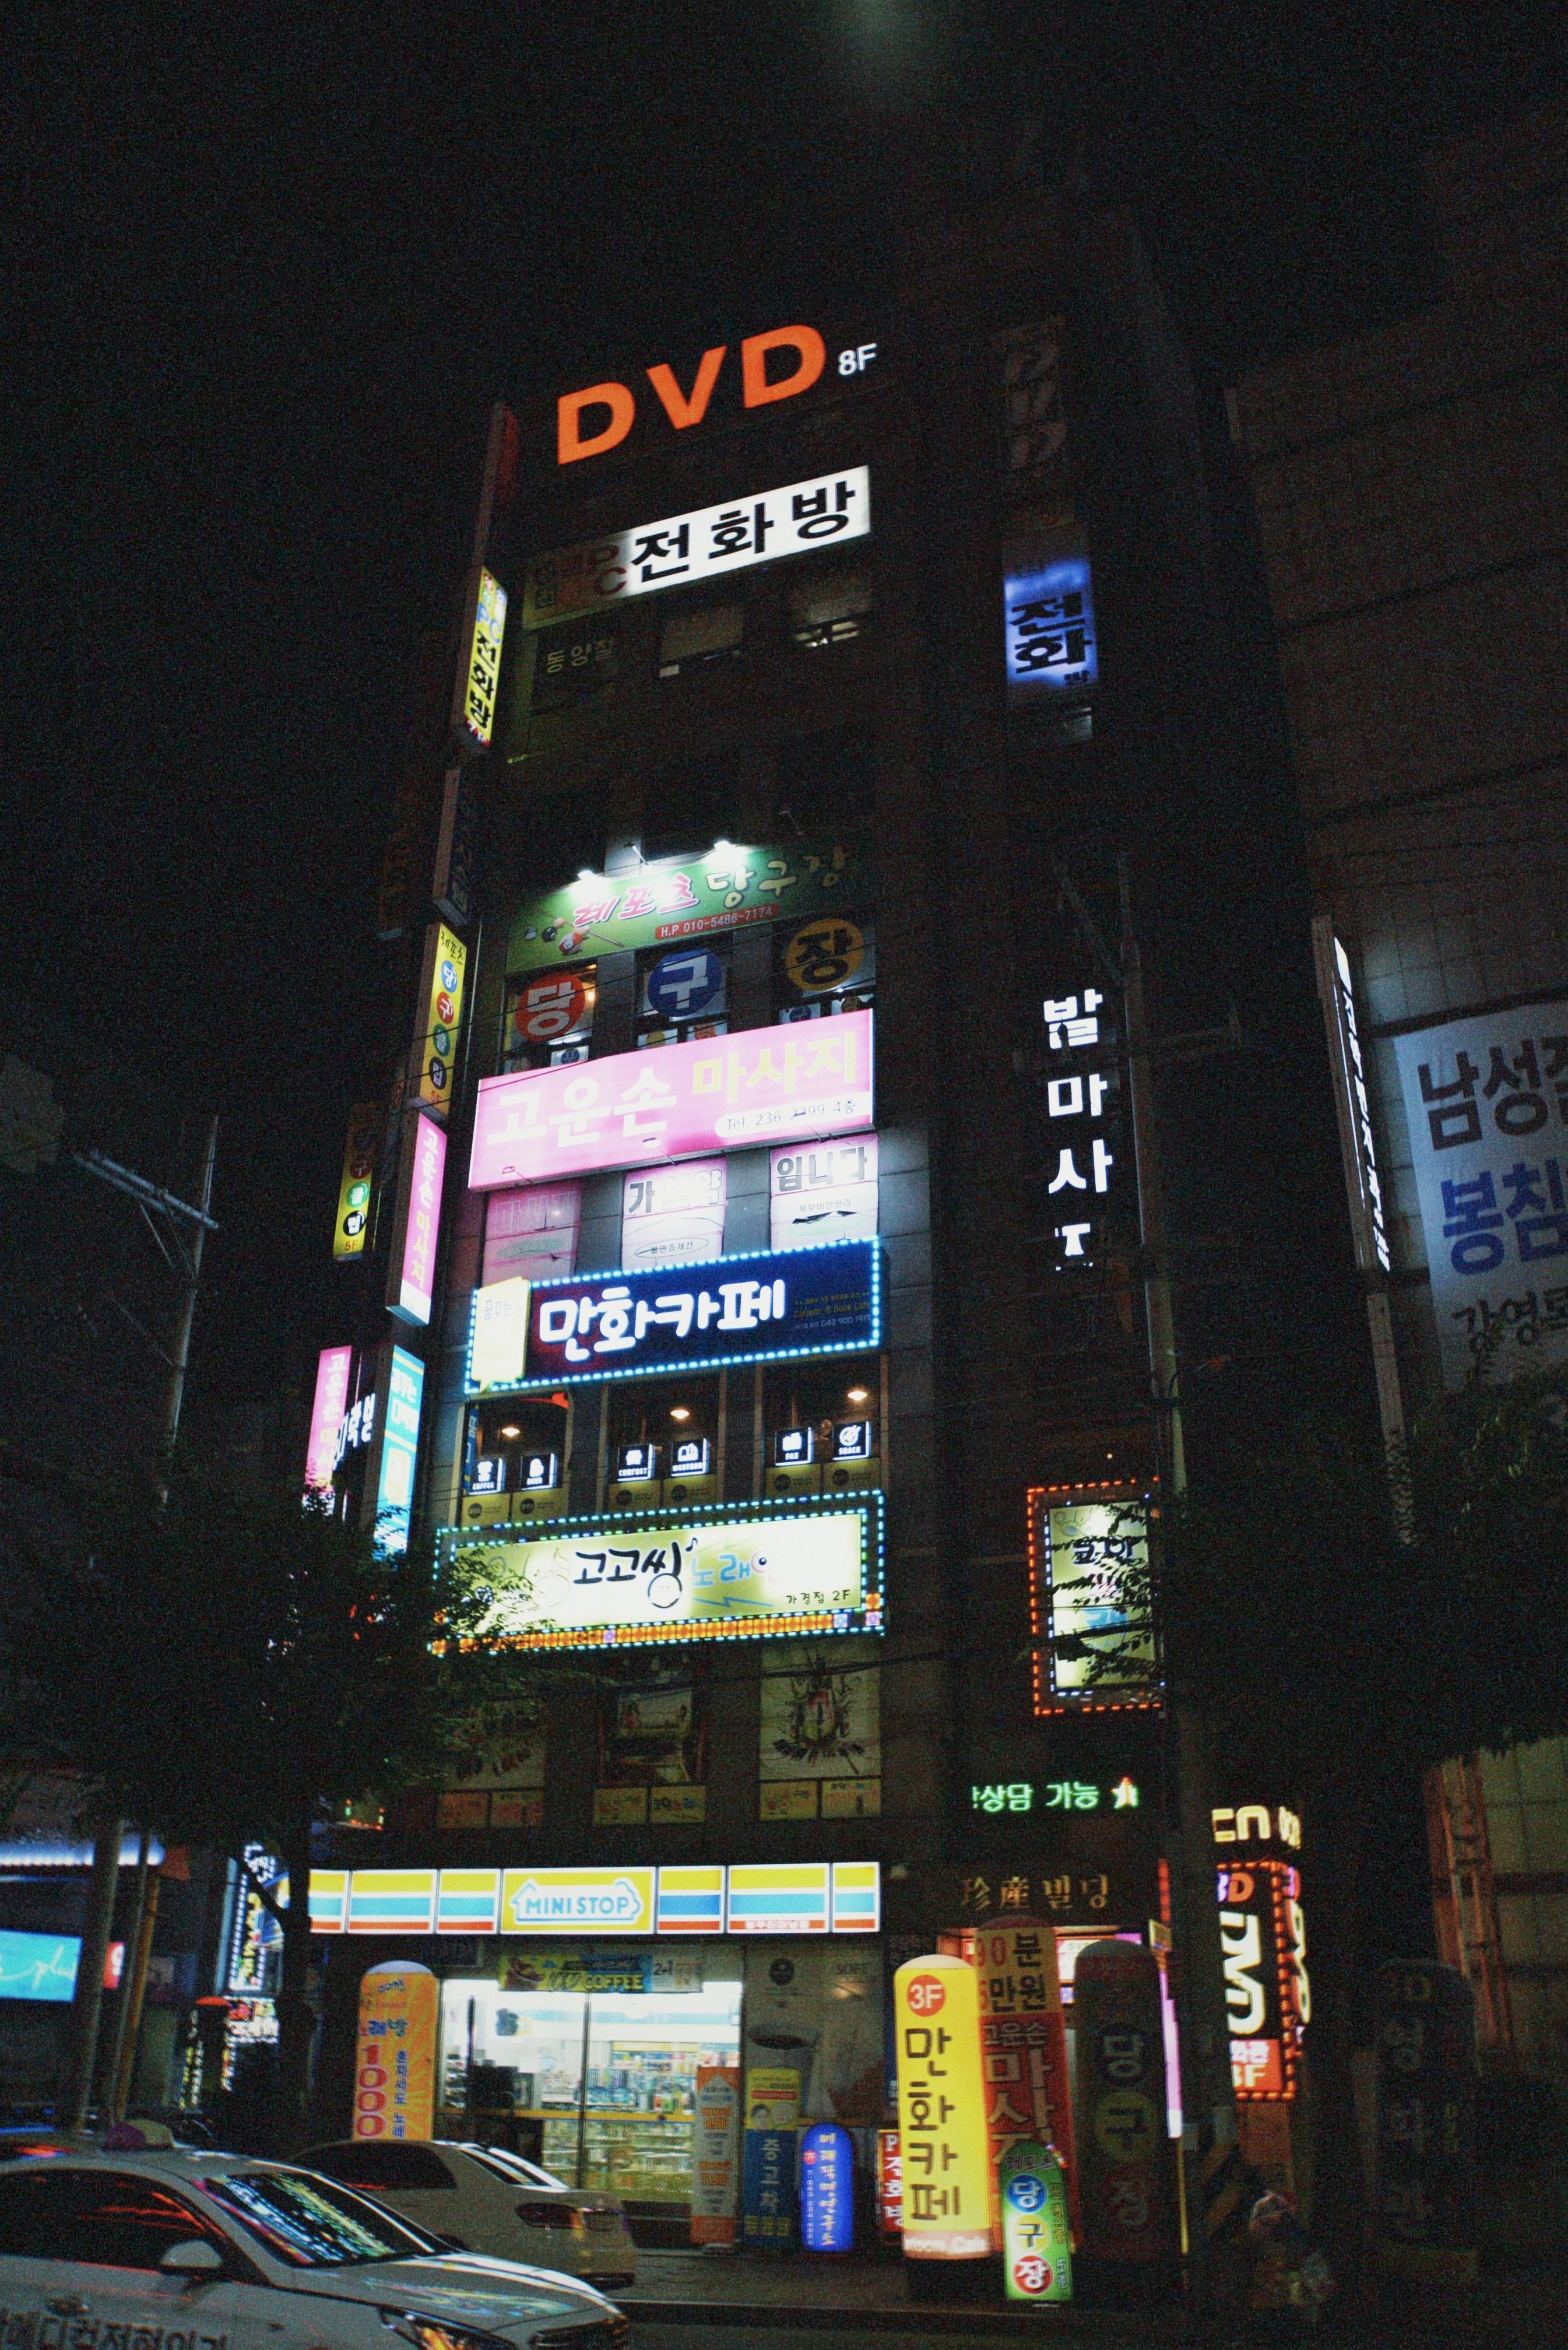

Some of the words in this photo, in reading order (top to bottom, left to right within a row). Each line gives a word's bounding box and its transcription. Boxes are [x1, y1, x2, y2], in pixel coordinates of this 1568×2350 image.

[557, 324, 827, 465] DVD
[838, 344, 876, 375] 8F
[631, 480, 855, 582] 전화방
[467, 630, 497, 730] 전화방
[573, 872, 699, 928] 레포츠
[705, 845, 850, 909] 당구장
[660, 925, 679, 940] H.P
[487, 1067, 677, 1148] 고운손
[692, 1031, 856, 1103] 마사지
[628, 1181, 655, 1213] 가
[776, 1146, 867, 1192] 입니다
[411, 1210, 431, 1289] 마사지
[540, 1279, 786, 1362] 만화카페
[821, 1319, 836, 1327] 043
[838, 1316, 853, 1325] 900
[833, 1590, 850, 1601] 2F
[1046, 1781, 1100, 1810] 가능
[584, 1974, 644, 1991] COFFEE
[909, 1985, 943, 2010] 3F
[356, 2044, 389, 2138] 1000
[906, 2027, 961, 2221] 만화카페
[1012, 2180, 1049, 2291] 당구장
